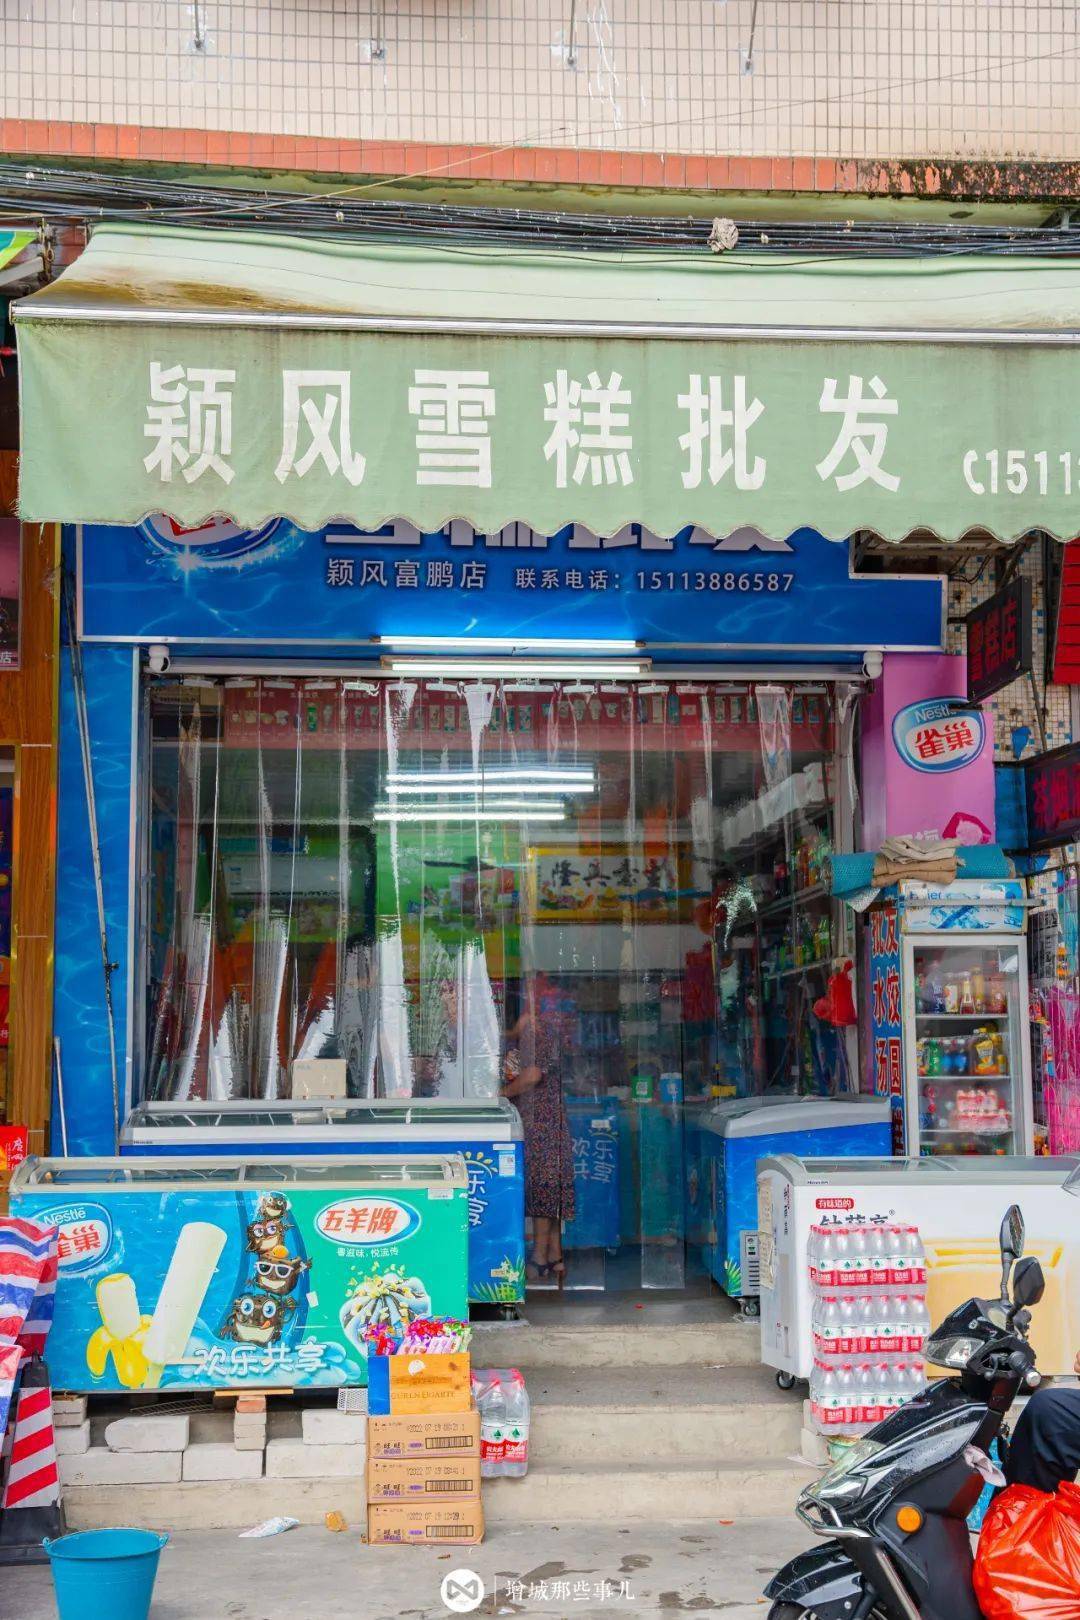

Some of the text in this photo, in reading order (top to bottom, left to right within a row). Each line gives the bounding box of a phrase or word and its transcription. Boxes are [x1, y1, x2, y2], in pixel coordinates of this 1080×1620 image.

[142, 360, 902, 493] 颖风雪糕批发
[985, 449, 1080, 495] 1511
[326, 557, 487, 589] 颖风富鹏店
[637, 571, 795, 592] 15113886587
[915, 703, 957, 721] Nestl
[915, 719, 974, 759] 雀巢
[323, 1207, 398, 1234] 五羊牌
[193, 1335, 328, 1378] 欢乐共享
